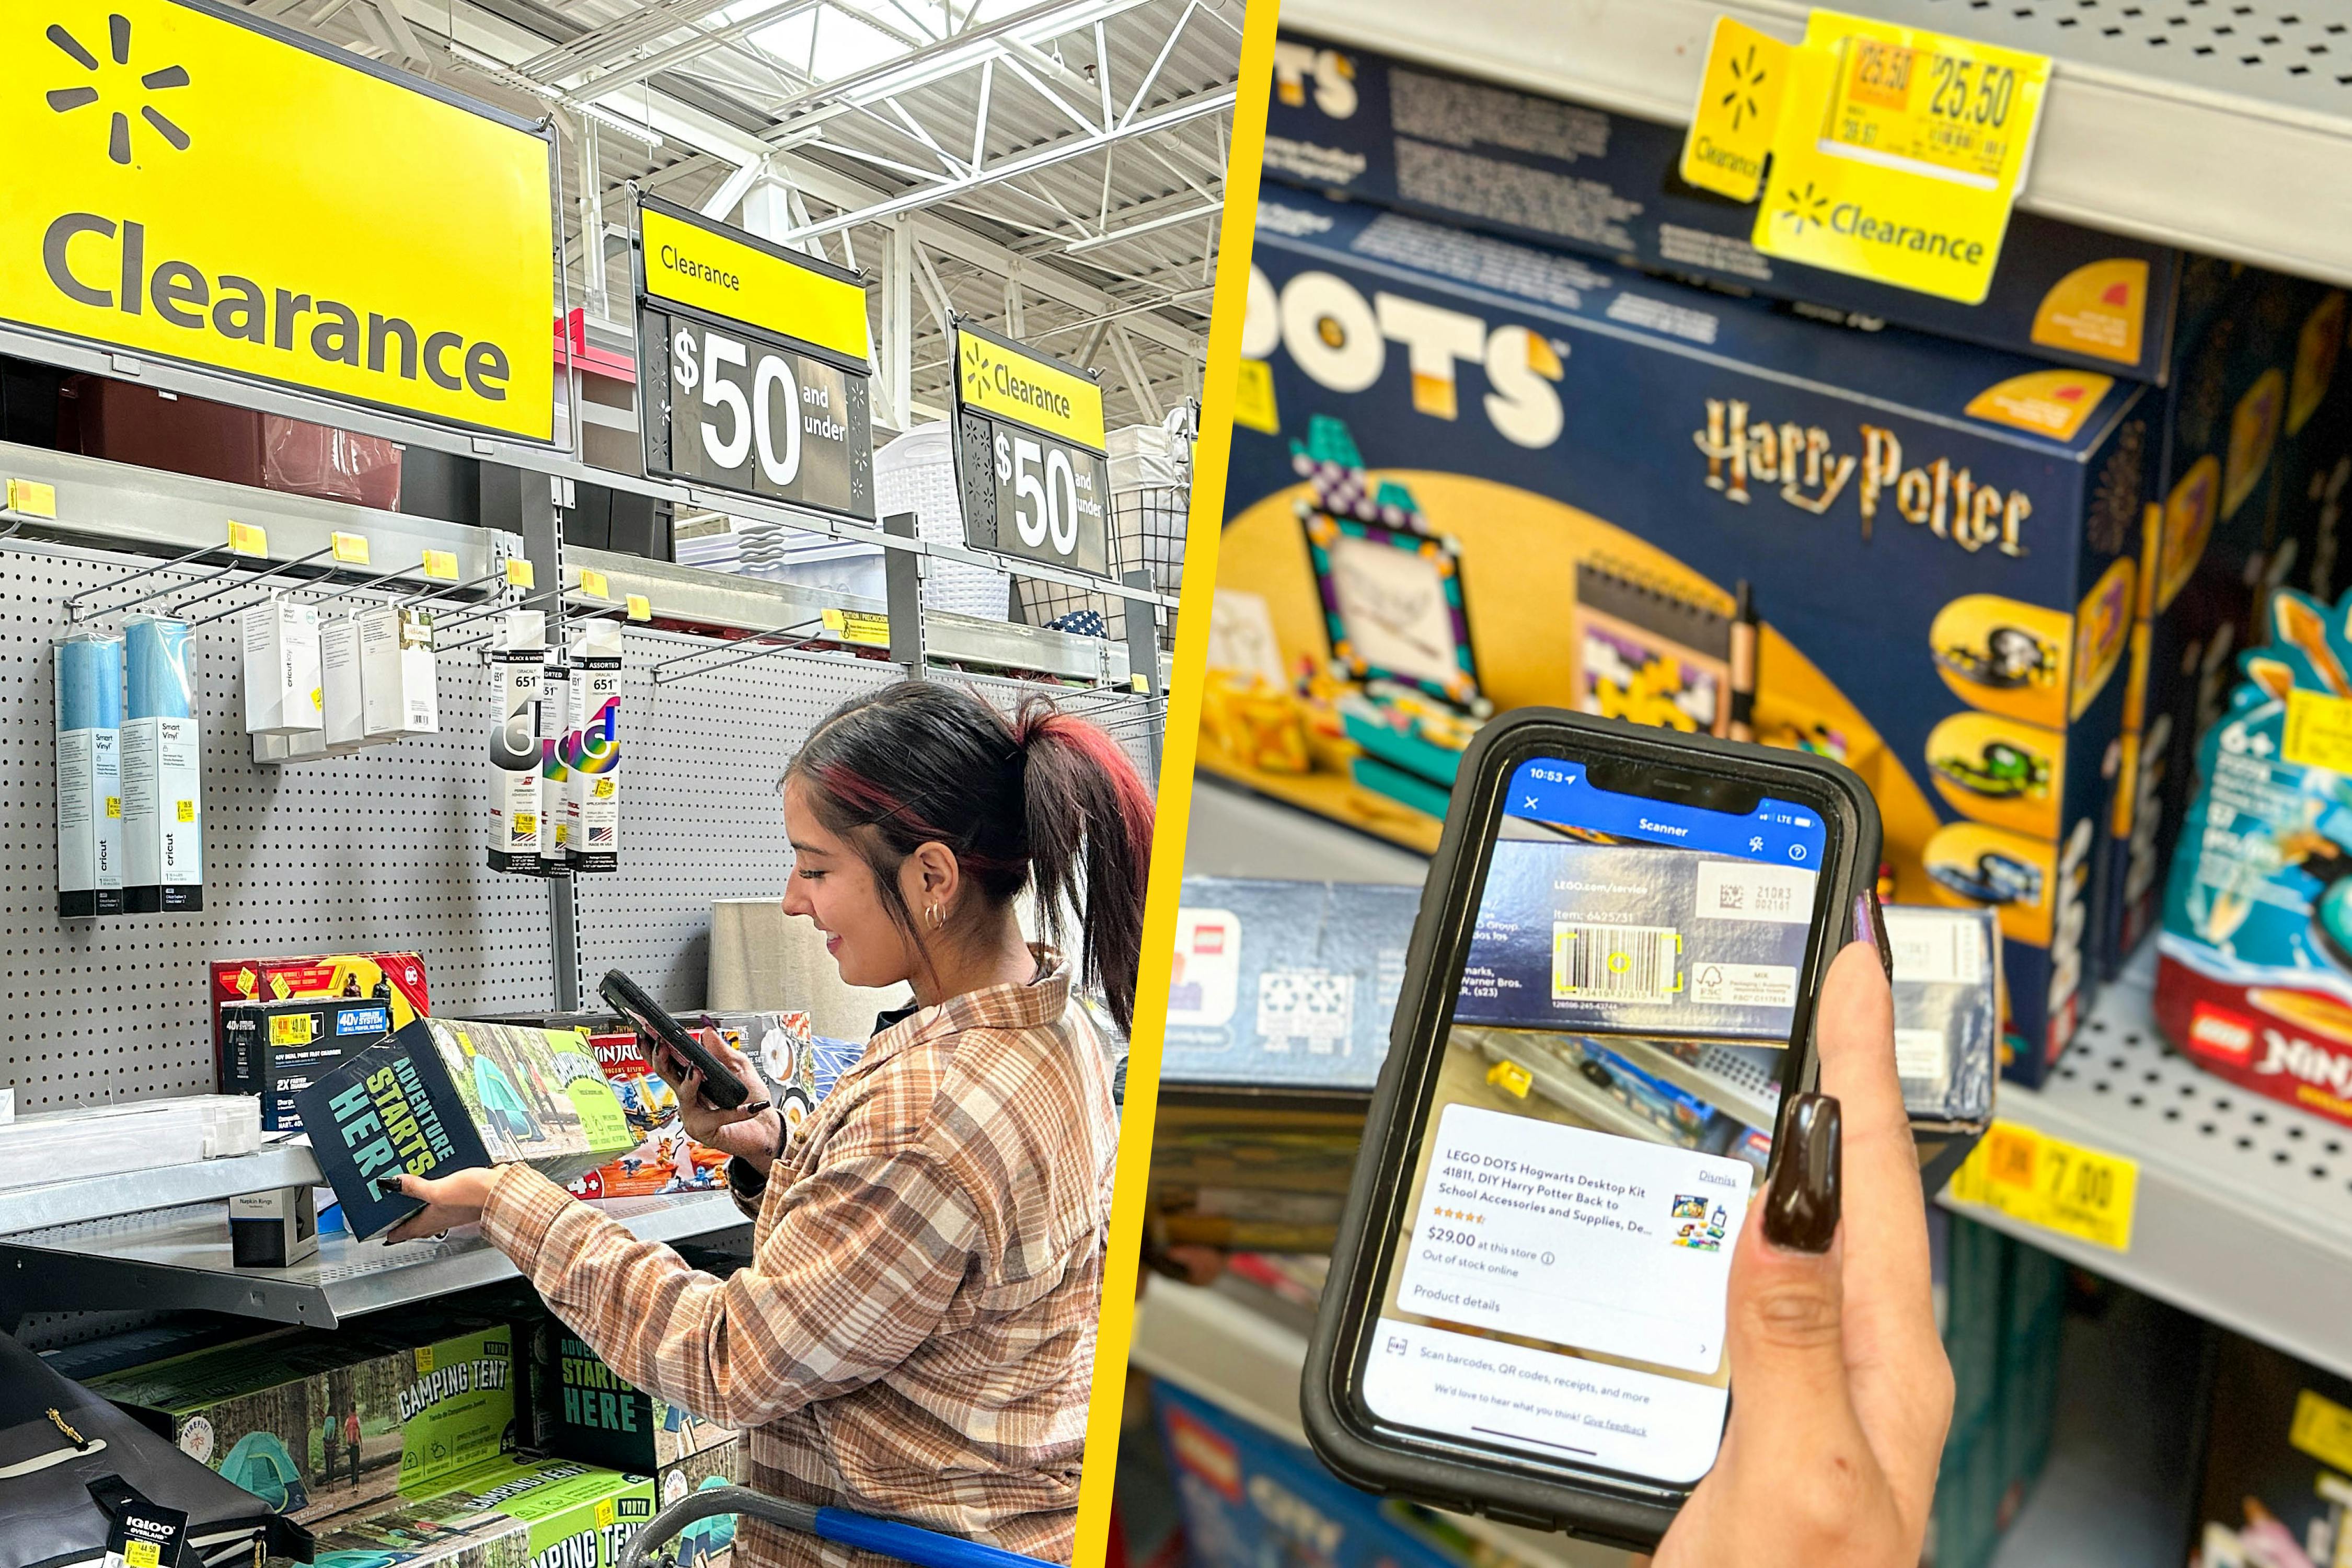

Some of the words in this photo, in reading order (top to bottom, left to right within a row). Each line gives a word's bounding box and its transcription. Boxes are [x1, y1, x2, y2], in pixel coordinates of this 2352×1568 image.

[1830, 202, 1985, 267] Clearance
[660, 244, 740, 292] Clearance
[42, 212, 510, 401] Clearance
[673, 327, 801, 486] $50
[803, 384, 828, 407] and
[995, 363, 1070, 419] Clearance
[804, 413, 846, 443] under
[995, 431, 1077, 555] $50
[1075, 471, 1092, 489] and
[1692, 398, 1857, 515] Harry
[1859, 422, 2033, 558] Potter
[1076, 495, 1102, 519] under
[1530, 768, 1563, 783] 10:53
[1639, 818, 1688, 837] Scanner
[1777, 814, 1792, 825] LTE
[405, 969, 418, 982] DC
[1497, 977, 1523, 988] Bros.
[1473, 987, 1498, 998] (s23)
[340, 1013, 358, 1027] 40V
[359, 1016, 383, 1025] SYSTEM
[276, 1079, 290, 1091] 2X
[366, 1066, 436, 1177] STARTS
[393, 1057, 455, 1162] ADVENTURE
[1442, 1166, 1475, 1183] 41811,
[1478, 1172, 1500, 1187] DIY
[1502, 1178, 1535, 1195] Harry
[1537, 1185, 1574, 1202] Potter
[1576, 1192, 1604, 1207] Back
[1607, 1198, 1619, 1211] to
[1447, 1148, 1481, 1165] LEGO
[1483, 1155, 1517, 1172] DOTS
[1519, 1163, 1575, 1184] Hogwarts
[1577, 1174, 1625, 1195] Desktop
[1629, 1185, 1646, 1198] Kit
[1699, 1169, 1737, 1187] Dismiss
[1438, 1182, 1478, 1201] School
[1479, 1191, 1546, 1214] Accessories
[1549, 1206, 1569, 1218] and
[1573, 1209, 1624, 1231] Supplies,
[1627, 1219, 1653, 1236] De...
[1427, 1225, 1476, 1247] $29.00
[1478, 1241, 1488, 1250] at
[1490, 1242, 1508, 1254] this
[1511, 1248, 1537, 1260] store
[1422, 1249, 1443, 1262] Out
[1445, 1255, 1457, 1264] of
[1458, 1257, 1485, 1271] stock
[1488, 1263, 1519, 1278] online
[1414, 1284, 1461, 1305] Product
[1463, 1295, 1501, 1312] details
[471, 1359, 509, 1391] TENT
[1420, 1346, 1445, 1361] Scan
[1446, 1353, 1495, 1374] barcodes,
[1498, 1363, 1517, 1376] QR
[1518, 1368, 1551, 1385] codes,
[1554, 1375, 1598, 1395] receipts,
[1600, 1387, 1621, 1398] and
[1622, 1391, 1651, 1404] more
[398, 1362, 469, 1422] CAMPING
[563, 1387, 637, 1433] HERE
[1435, 1382, 1457, 1397] We'd
[1459, 1388, 1478, 1400] love
[1479, 1393, 1489, 1403] to
[1491, 1395, 1511, 1407] hear
[1513, 1400, 1535, 1412] what
[1536, 1405, 1553, 1417] you
[1554, 1408, 1581, 1421] think!
[1583, 1414, 1605, 1428] Give
[1606, 1419, 1648, 1437] feedback
[184, 1420, 210, 1438] FIREFLY!
[539, 1465, 592, 1481] TENT
[465, 1477, 546, 1509] CAMPING
[621, 1501, 648, 1515] YOUTH
[520, 1529, 598, 1568] MPING
